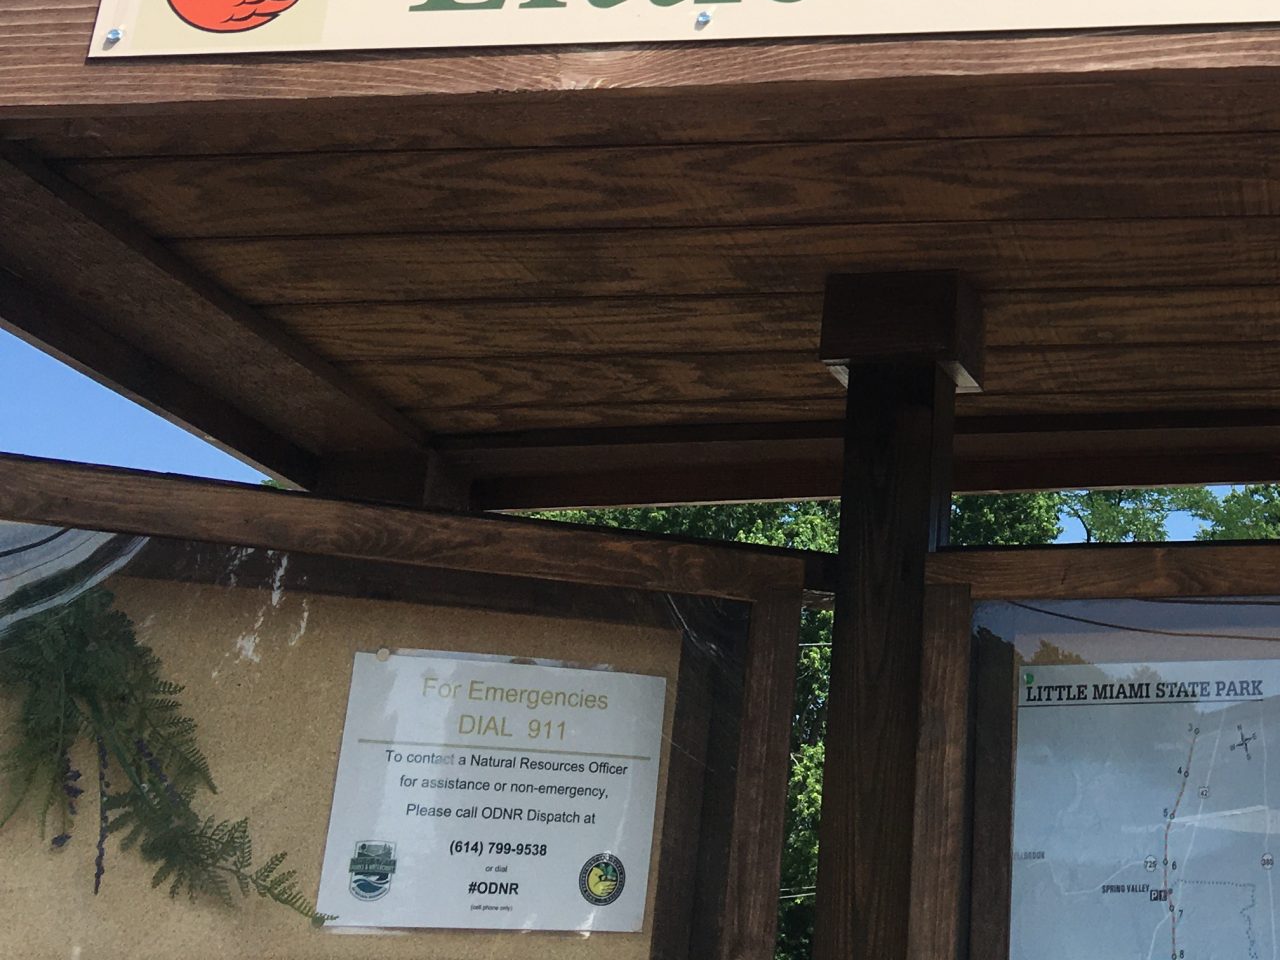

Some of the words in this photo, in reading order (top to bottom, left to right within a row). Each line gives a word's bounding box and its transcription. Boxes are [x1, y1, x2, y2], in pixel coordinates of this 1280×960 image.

[422, 677, 462, 700] For
[468, 680, 609, 710] Emergencies
[1026, 684, 1088, 702] LITTLE
[1092, 682, 1151, 700] MIAMI
[1155, 681, 1210, 699] STATE
[1215, 680, 1264, 697] PARK
[458, 714, 513, 737] DIAL
[528, 719, 566, 740] 911
[386, 750, 403, 763] To
[407, 751, 455, 765] contact
[458, 756, 467, 766] a
[470, 754, 517, 769] Natural
[520, 757, 585, 772] Resources
[588, 760, 629, 775] Officer
[400, 775, 417, 788] for
[421, 777, 490, 791] assistance
[494, 782, 507, 792] or
[510, 783, 609, 800] non-emergency,
[406, 803, 452, 818] Please
[456, 805, 478, 819] call
[481, 807, 523, 821] ODNR
[527, 809, 580, 825] Dispatch
[583, 813, 596, 825] at
[449, 839, 484, 856] (614)
[488, 842, 548, 856] 799-9538
[467, 881, 519, 895] #ODNR
[1102, 885, 1126, 894] SPRING
[1126, 884, 1150, 893] VALLEY
